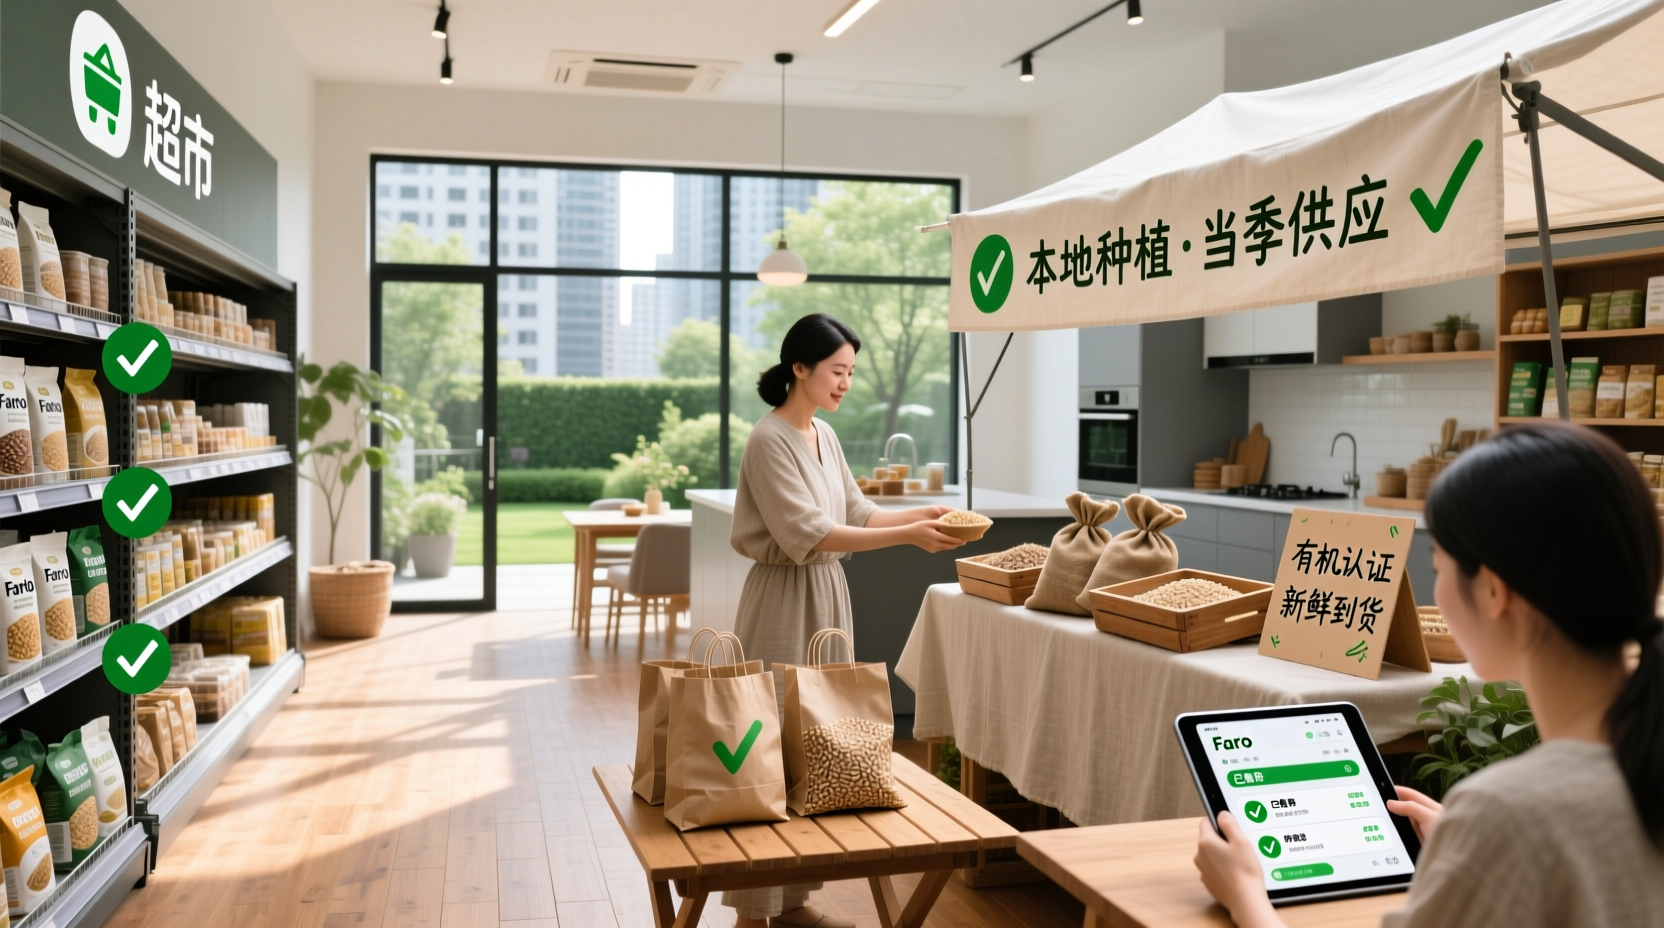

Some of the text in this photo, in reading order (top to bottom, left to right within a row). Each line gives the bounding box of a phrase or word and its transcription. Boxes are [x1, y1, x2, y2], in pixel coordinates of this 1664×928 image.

[143, 79, 215, 200] 超市
[1026, 173, 1389, 294] 本地种植·当季供应
[1291, 538, 1395, 583] 有机认证
[1280, 584, 1384, 635] 新鲜到货
[1212, 736, 1253, 751] Faro
